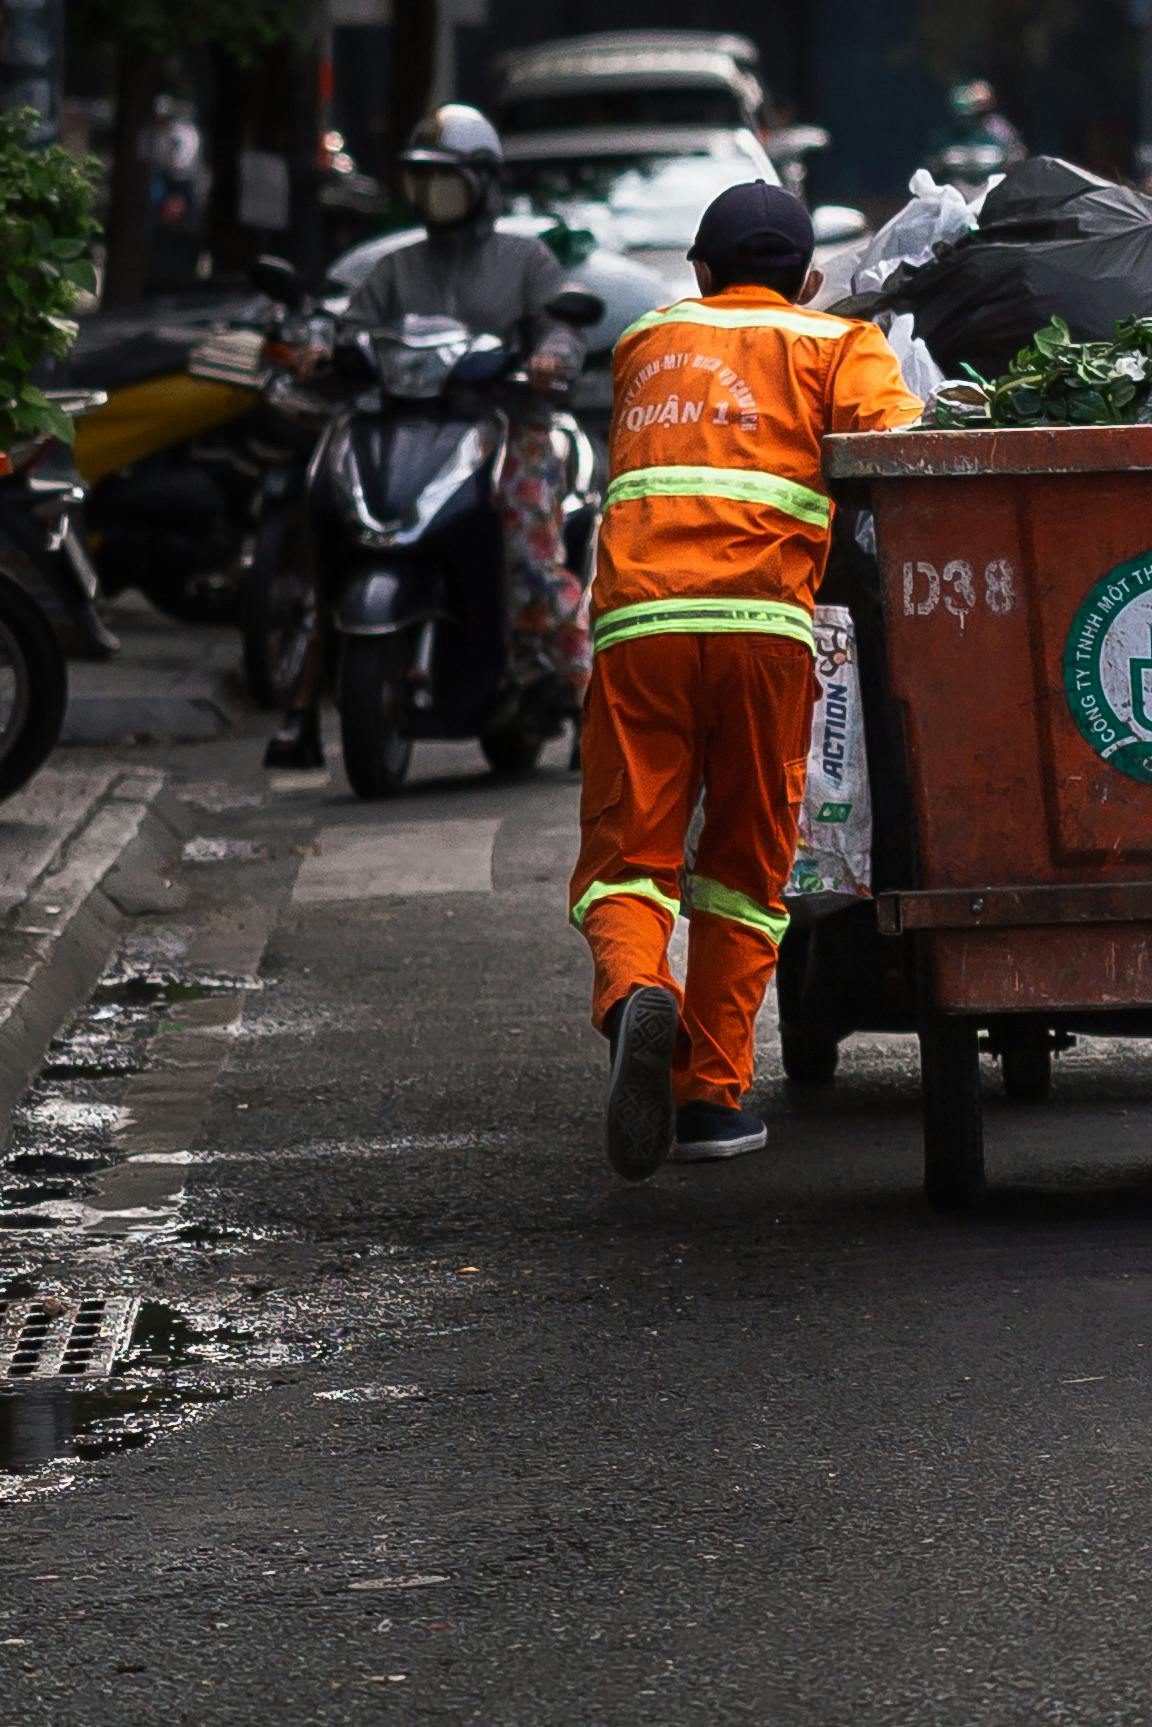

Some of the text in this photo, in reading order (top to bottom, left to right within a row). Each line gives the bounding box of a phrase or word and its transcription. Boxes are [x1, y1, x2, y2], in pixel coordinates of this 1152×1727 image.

[626, 394, 704, 432] QUẬN
[712, 401, 729, 425] 1
[902, 559, 1017, 617] D38
[1097, 578, 1132, 614] MỘT
[1076, 614, 1104, 660] TNHH
[1076, 669, 1091, 691] TY
[822, 682, 849, 785] ACTION
[1080, 696, 1116, 742] CÔNG
